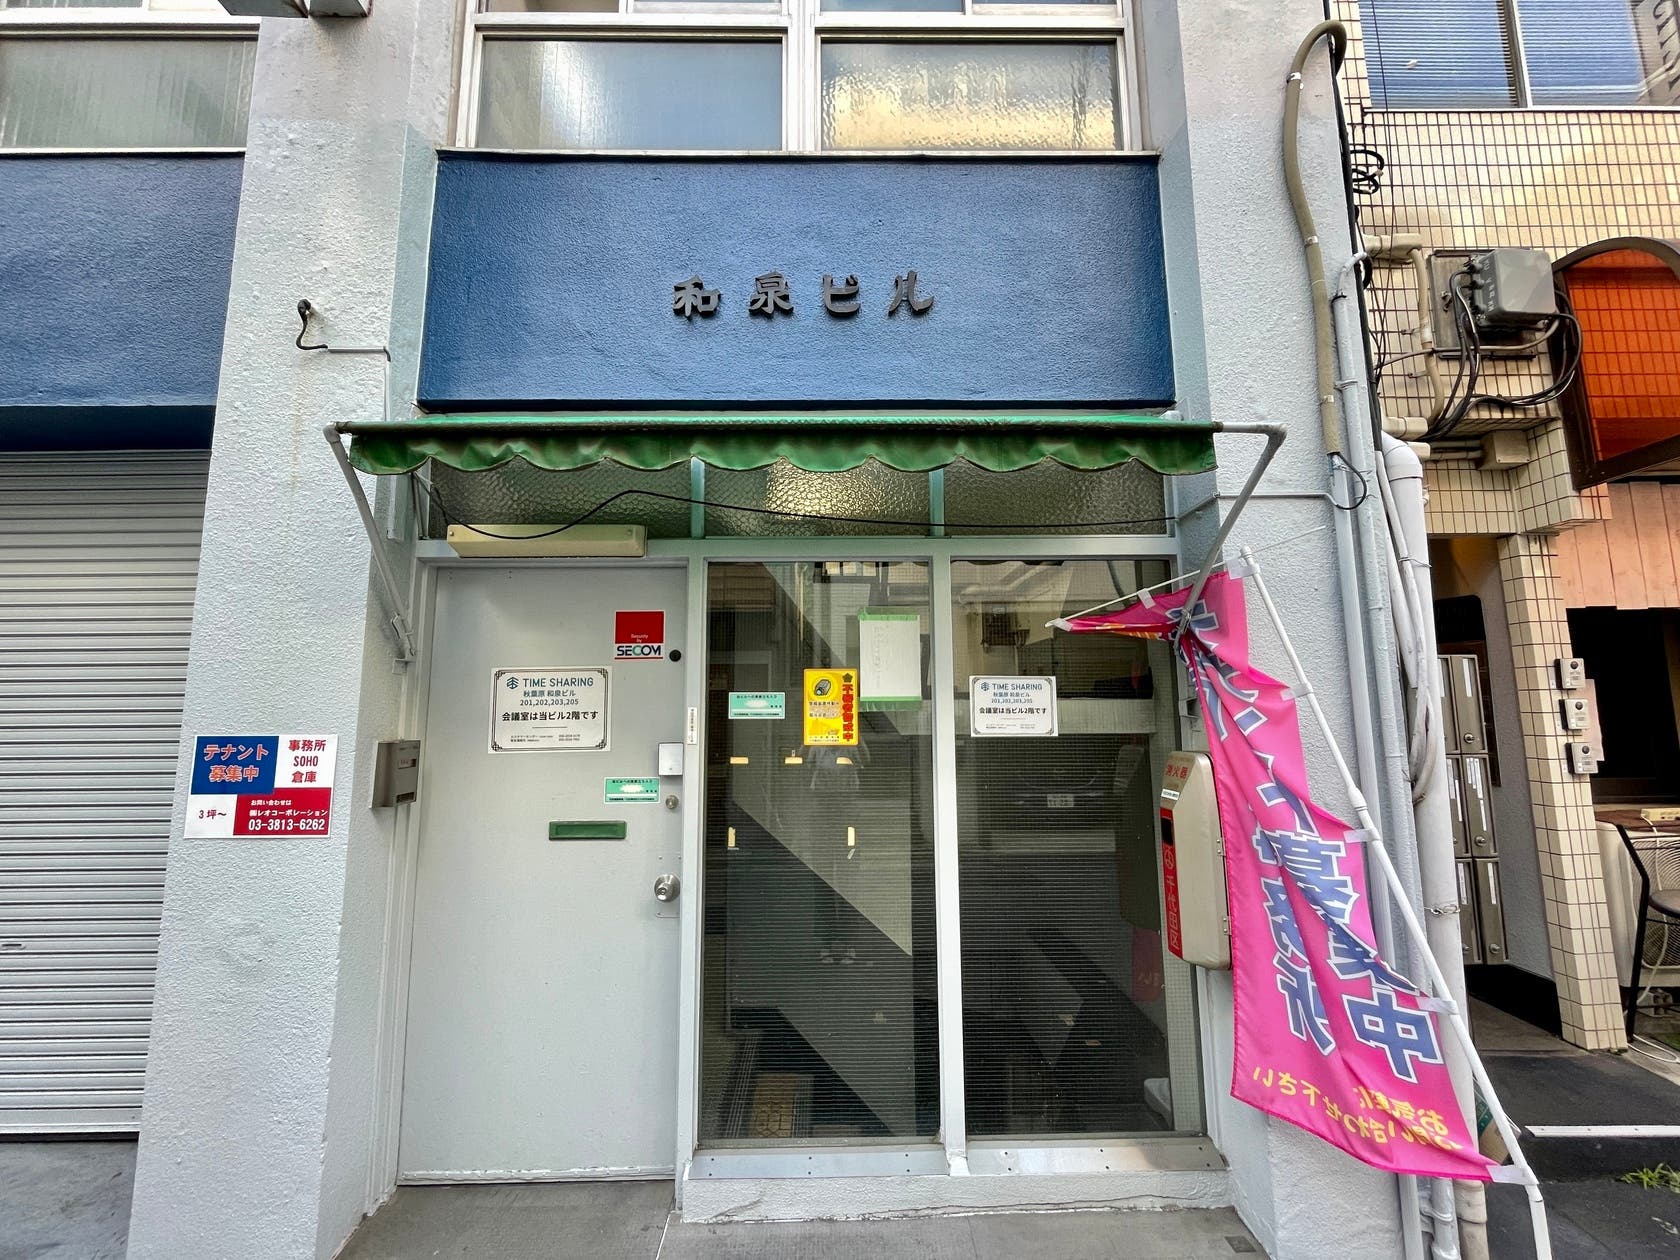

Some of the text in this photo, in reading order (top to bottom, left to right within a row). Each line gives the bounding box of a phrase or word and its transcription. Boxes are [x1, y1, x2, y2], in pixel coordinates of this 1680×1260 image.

[673, 270, 935, 320] 和泉ビル
[616, 644, 662, 656] SECOM
[522, 676, 594, 688] TIME SHARING
[992, 683, 1043, 691] TIME SHARING
[520, 698, 579, 707] 201,202,203,205
[502, 710, 599, 722] 会議室は当ビル2階です
[288, 739, 327, 753] 事務所
[203, 744, 269, 761] テナント
[293, 755, 319, 767] SOHO
[208, 765, 260, 782] 募集中
[291, 771, 317, 783] 倉庫
[248, 818, 325, 831] 03-3813-6262
